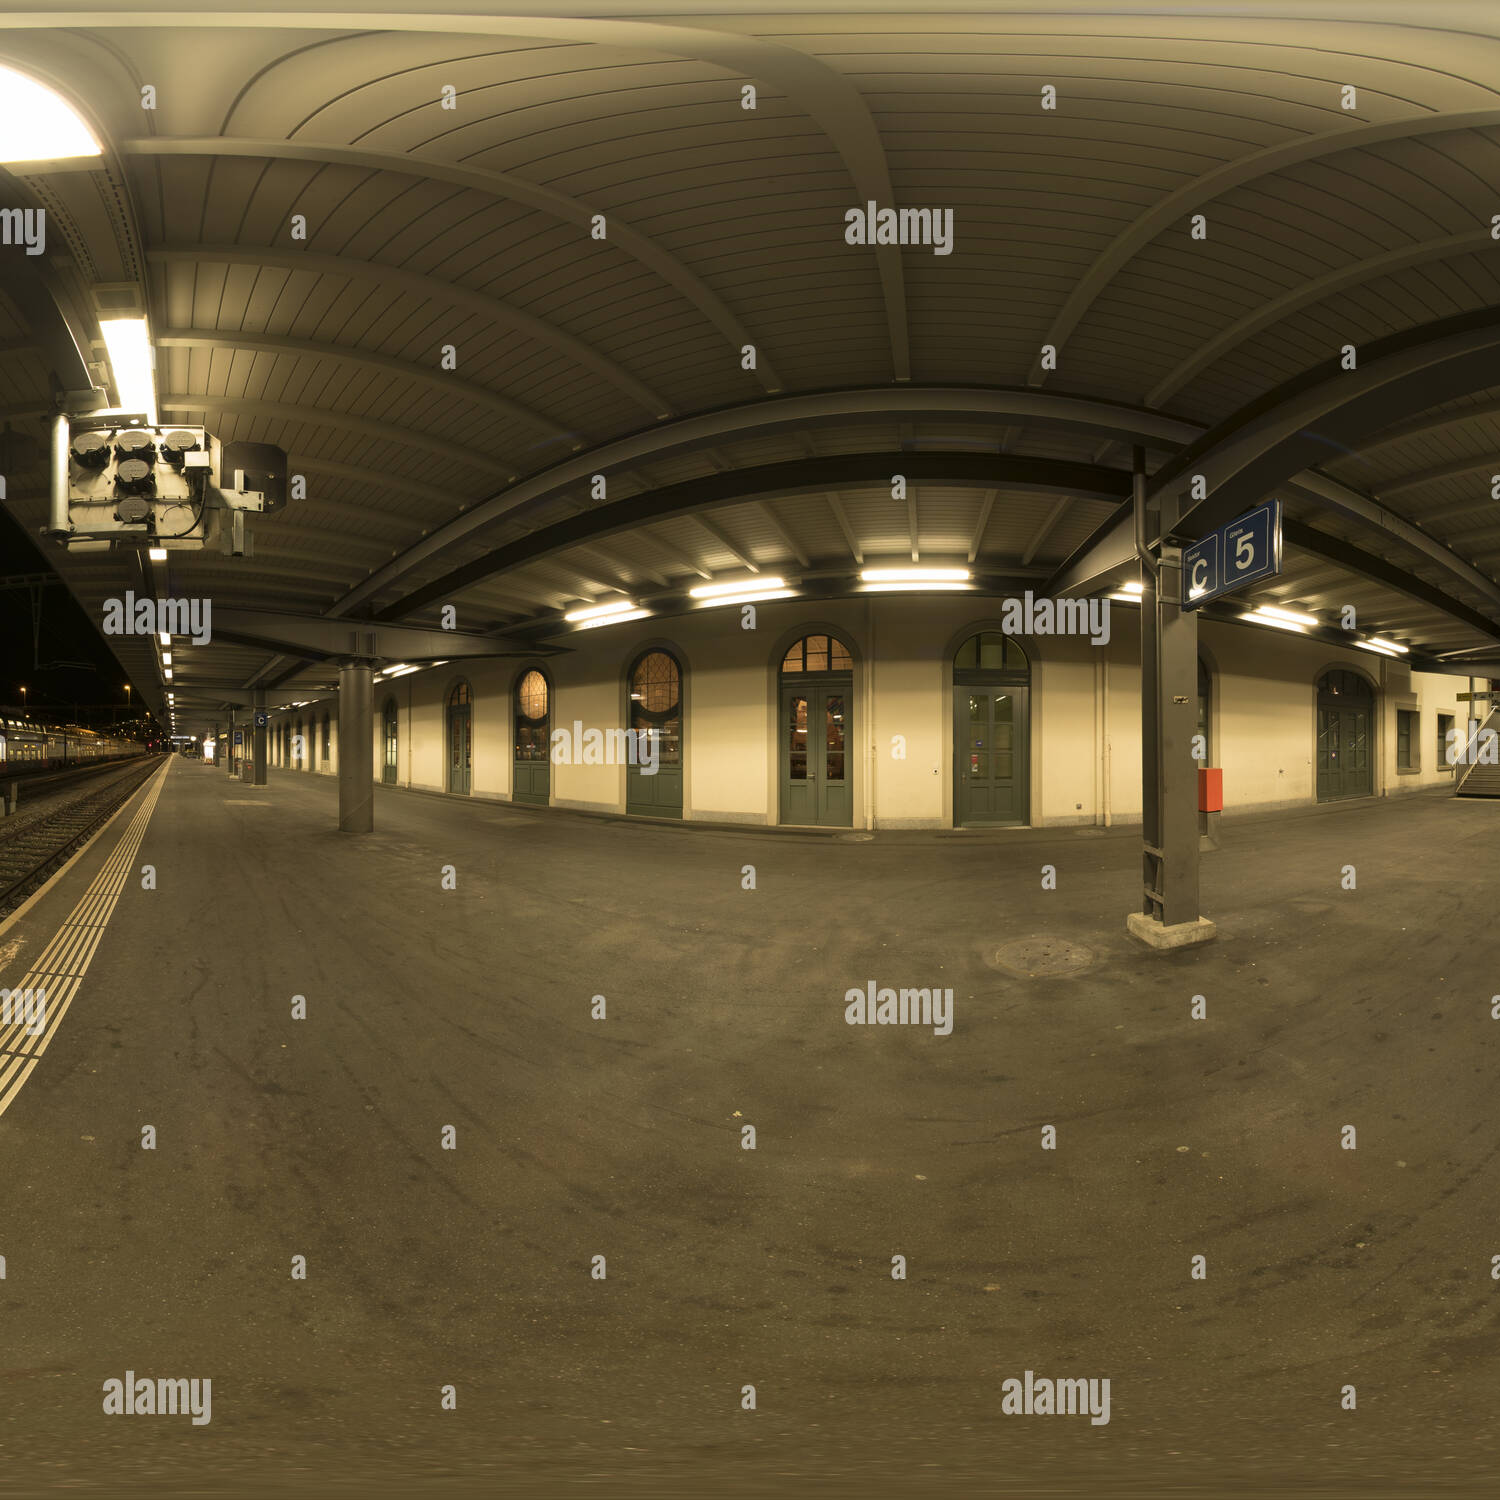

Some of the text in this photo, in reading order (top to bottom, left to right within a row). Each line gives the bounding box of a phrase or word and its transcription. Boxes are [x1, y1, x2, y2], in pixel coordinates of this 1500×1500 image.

[1235, 531, 1255, 570] 5
[1192, 559, 1208, 590] C
[258, 716, 265, 725] C
